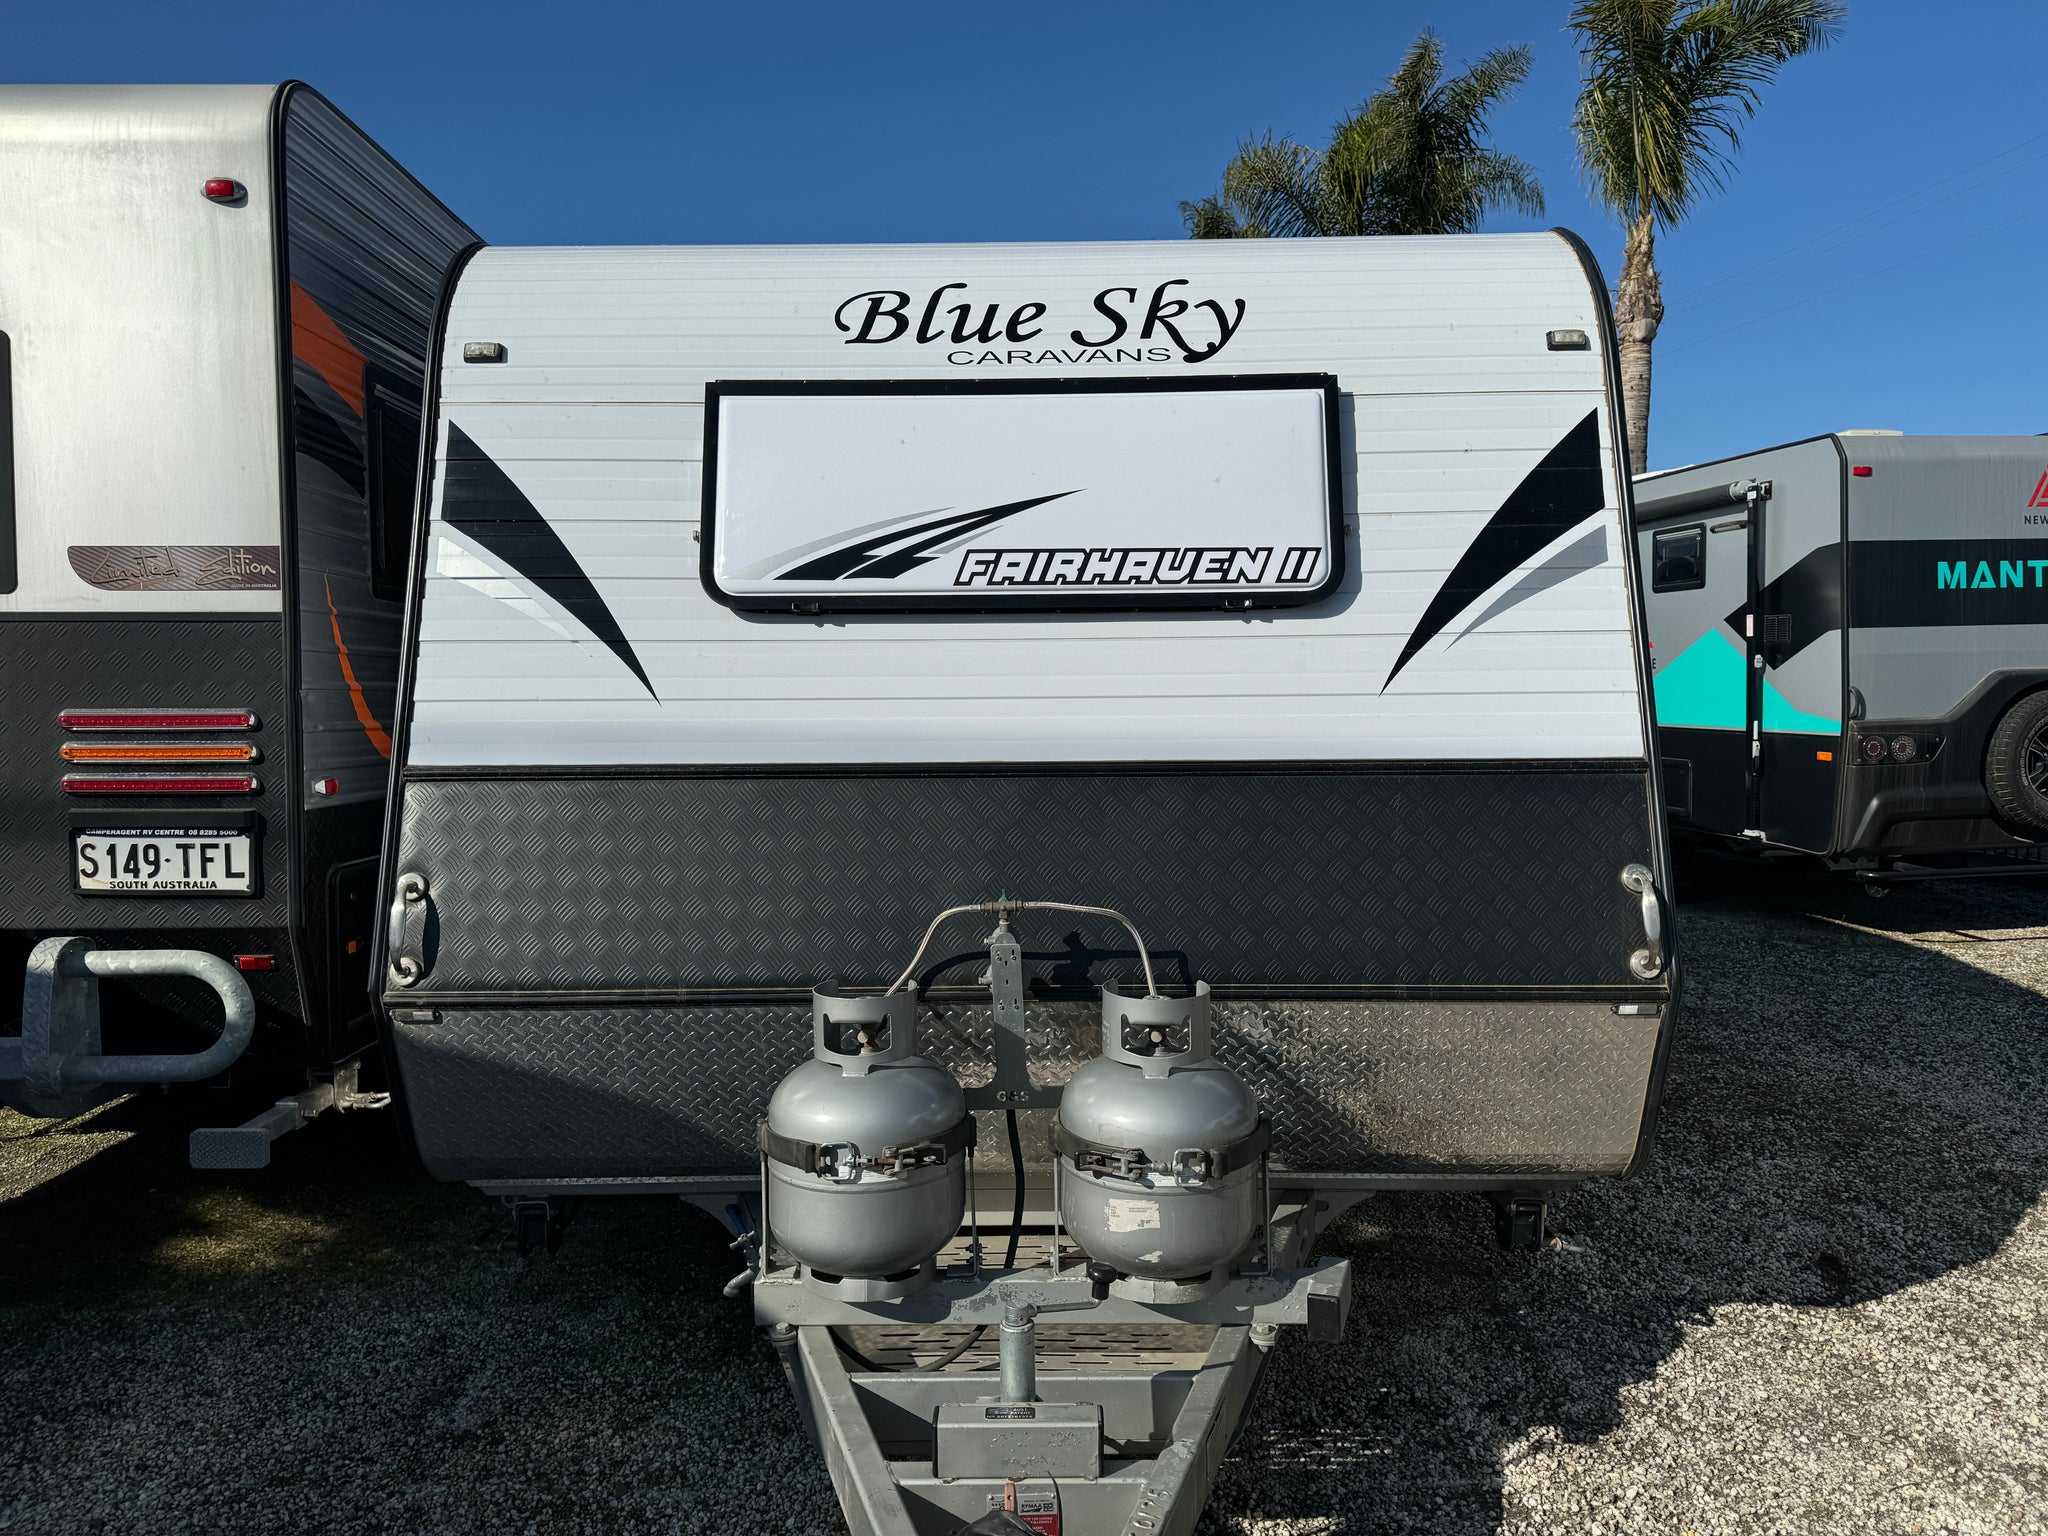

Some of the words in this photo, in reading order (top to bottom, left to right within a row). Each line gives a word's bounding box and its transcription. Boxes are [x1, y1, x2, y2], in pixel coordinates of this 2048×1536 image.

[834, 282, 1048, 345] Blue
[1070, 279, 1246, 364] Sky
[947, 347, 1171, 365] CARAVANS
[89, 546, 181, 584] Limited
[195, 547, 277, 585] Edition
[1937, 560, 2048, 589] MANT
[85, 828, 141, 836] CAMPERAGENT
[109, 880, 148, 889] SOUTH
[152, 880, 218, 889] AUSTRALIA
